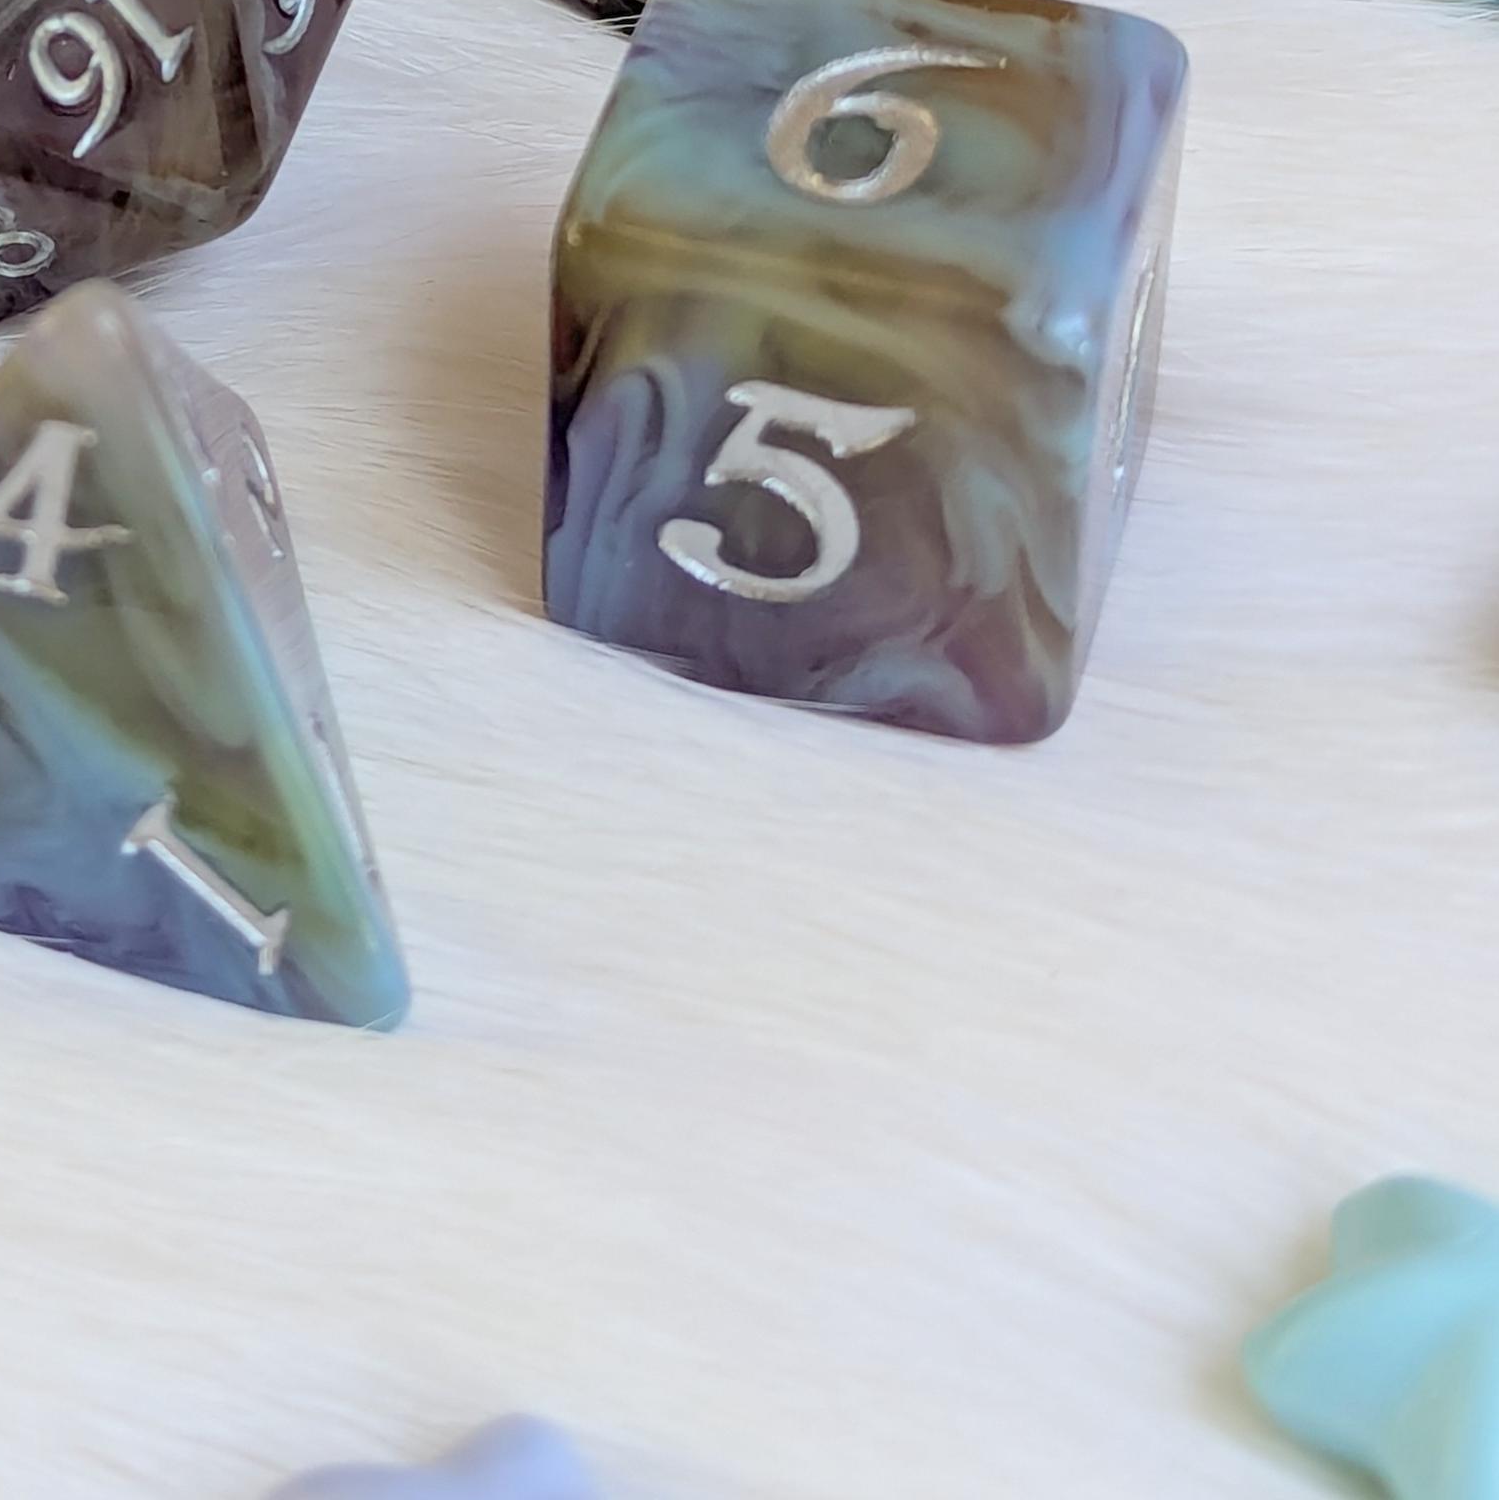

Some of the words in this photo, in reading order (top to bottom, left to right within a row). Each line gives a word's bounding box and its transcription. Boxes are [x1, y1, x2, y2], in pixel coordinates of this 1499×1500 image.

[766, 44, 1008, 204] 6
[657, 378, 916, 603] 5
[120, 791, 290, 977] 1
